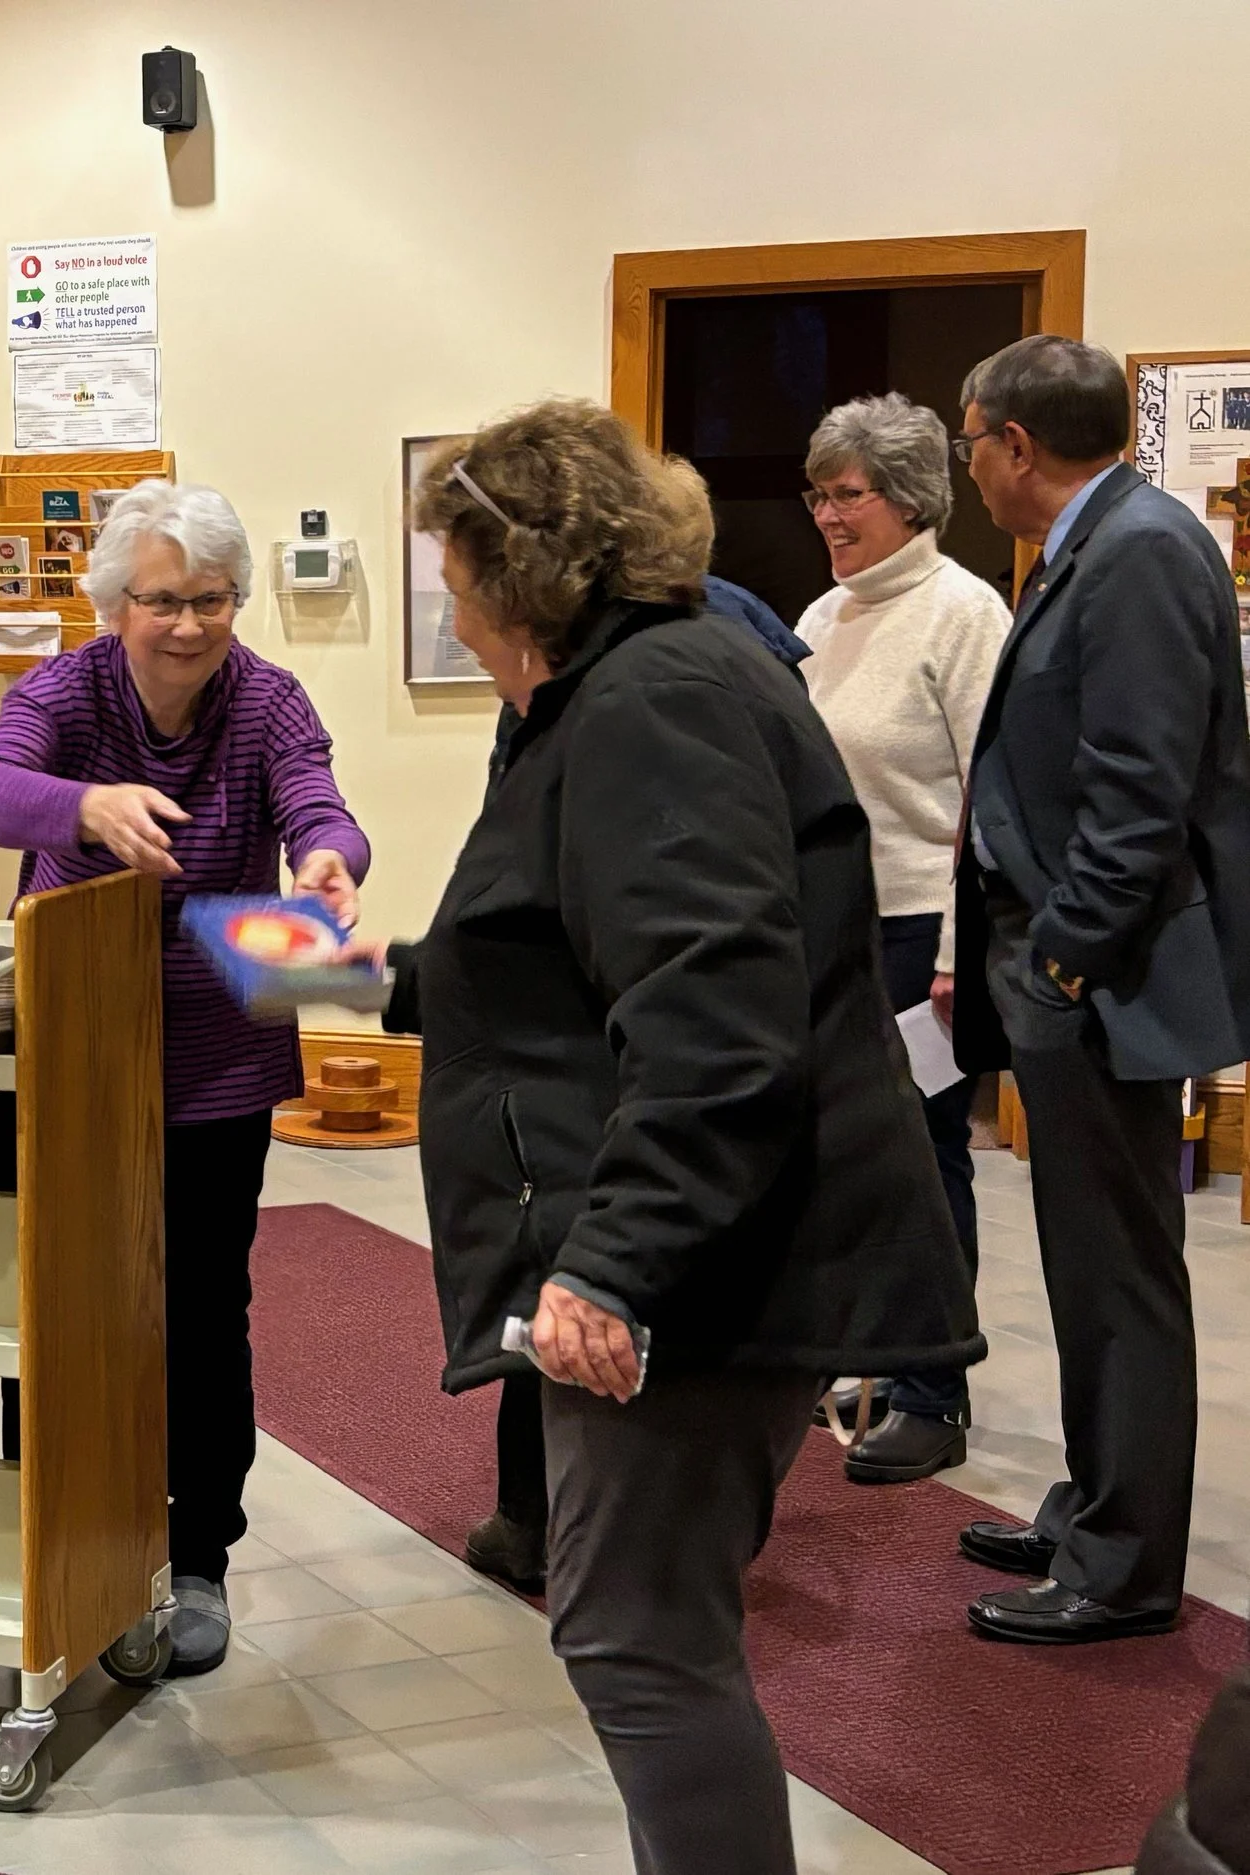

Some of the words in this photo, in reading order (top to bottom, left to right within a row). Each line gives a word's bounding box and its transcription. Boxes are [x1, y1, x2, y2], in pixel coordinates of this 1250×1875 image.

[55, 259, 70, 271] Say
[72, 258, 85, 269] NO
[86, 257, 95, 267] in
[96, 259, 102, 267] a
[103, 255, 123, 266] loud
[124, 254, 148, 264] voice
[55, 281, 68, 291] GO
[70, 282, 79, 291] to
[80, 282, 86, 290] a
[87, 278, 105, 289] safe
[106, 277, 129, 290] place
[130, 275, 150, 286] with
[55, 293, 78, 303] other
[80, 291, 110, 304] people
[55, 306, 75, 318] TELL
[76, 309, 82, 317] a
[84, 304, 114, 316] trusted
[116, 304, 146, 317] person
[55, 318, 76, 329] what
[78, 318, 93, 328] has
[94, 315, 138, 329] happened
